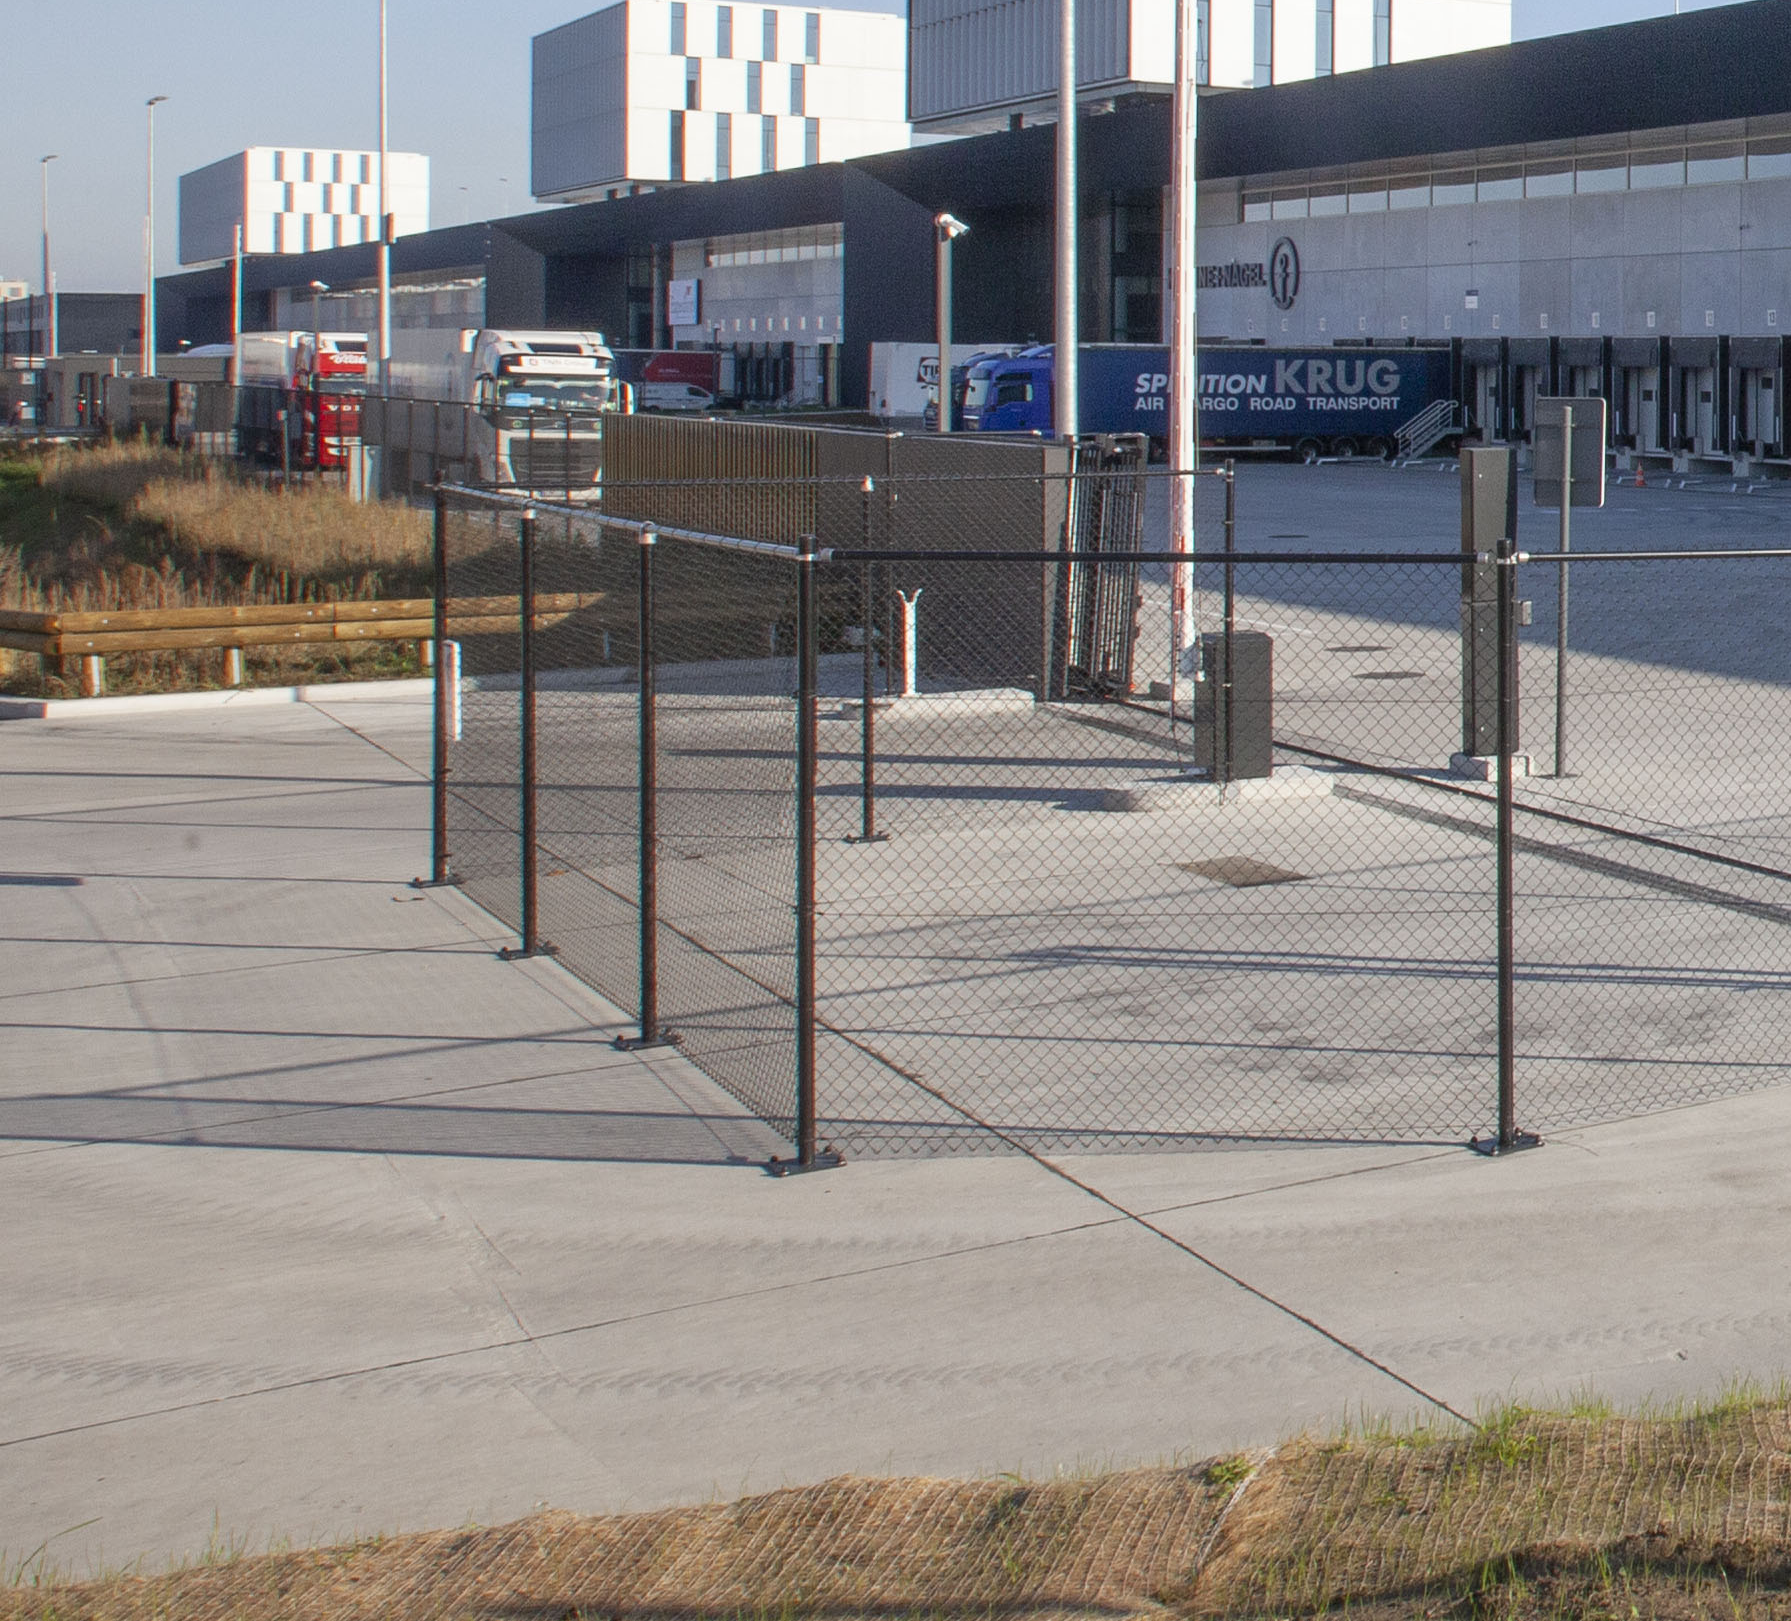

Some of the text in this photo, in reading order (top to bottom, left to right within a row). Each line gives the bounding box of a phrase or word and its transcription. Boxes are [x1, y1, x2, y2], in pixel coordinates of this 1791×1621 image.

[1168, 263, 1267, 289] NE+NAGEL
[1134, 359, 1400, 395] SPITION KRUG
[1134, 397, 1165, 411] AIR
[1249, 397, 1297, 411] ROAD
[1306, 396, 1400, 411] TRANSPORT
